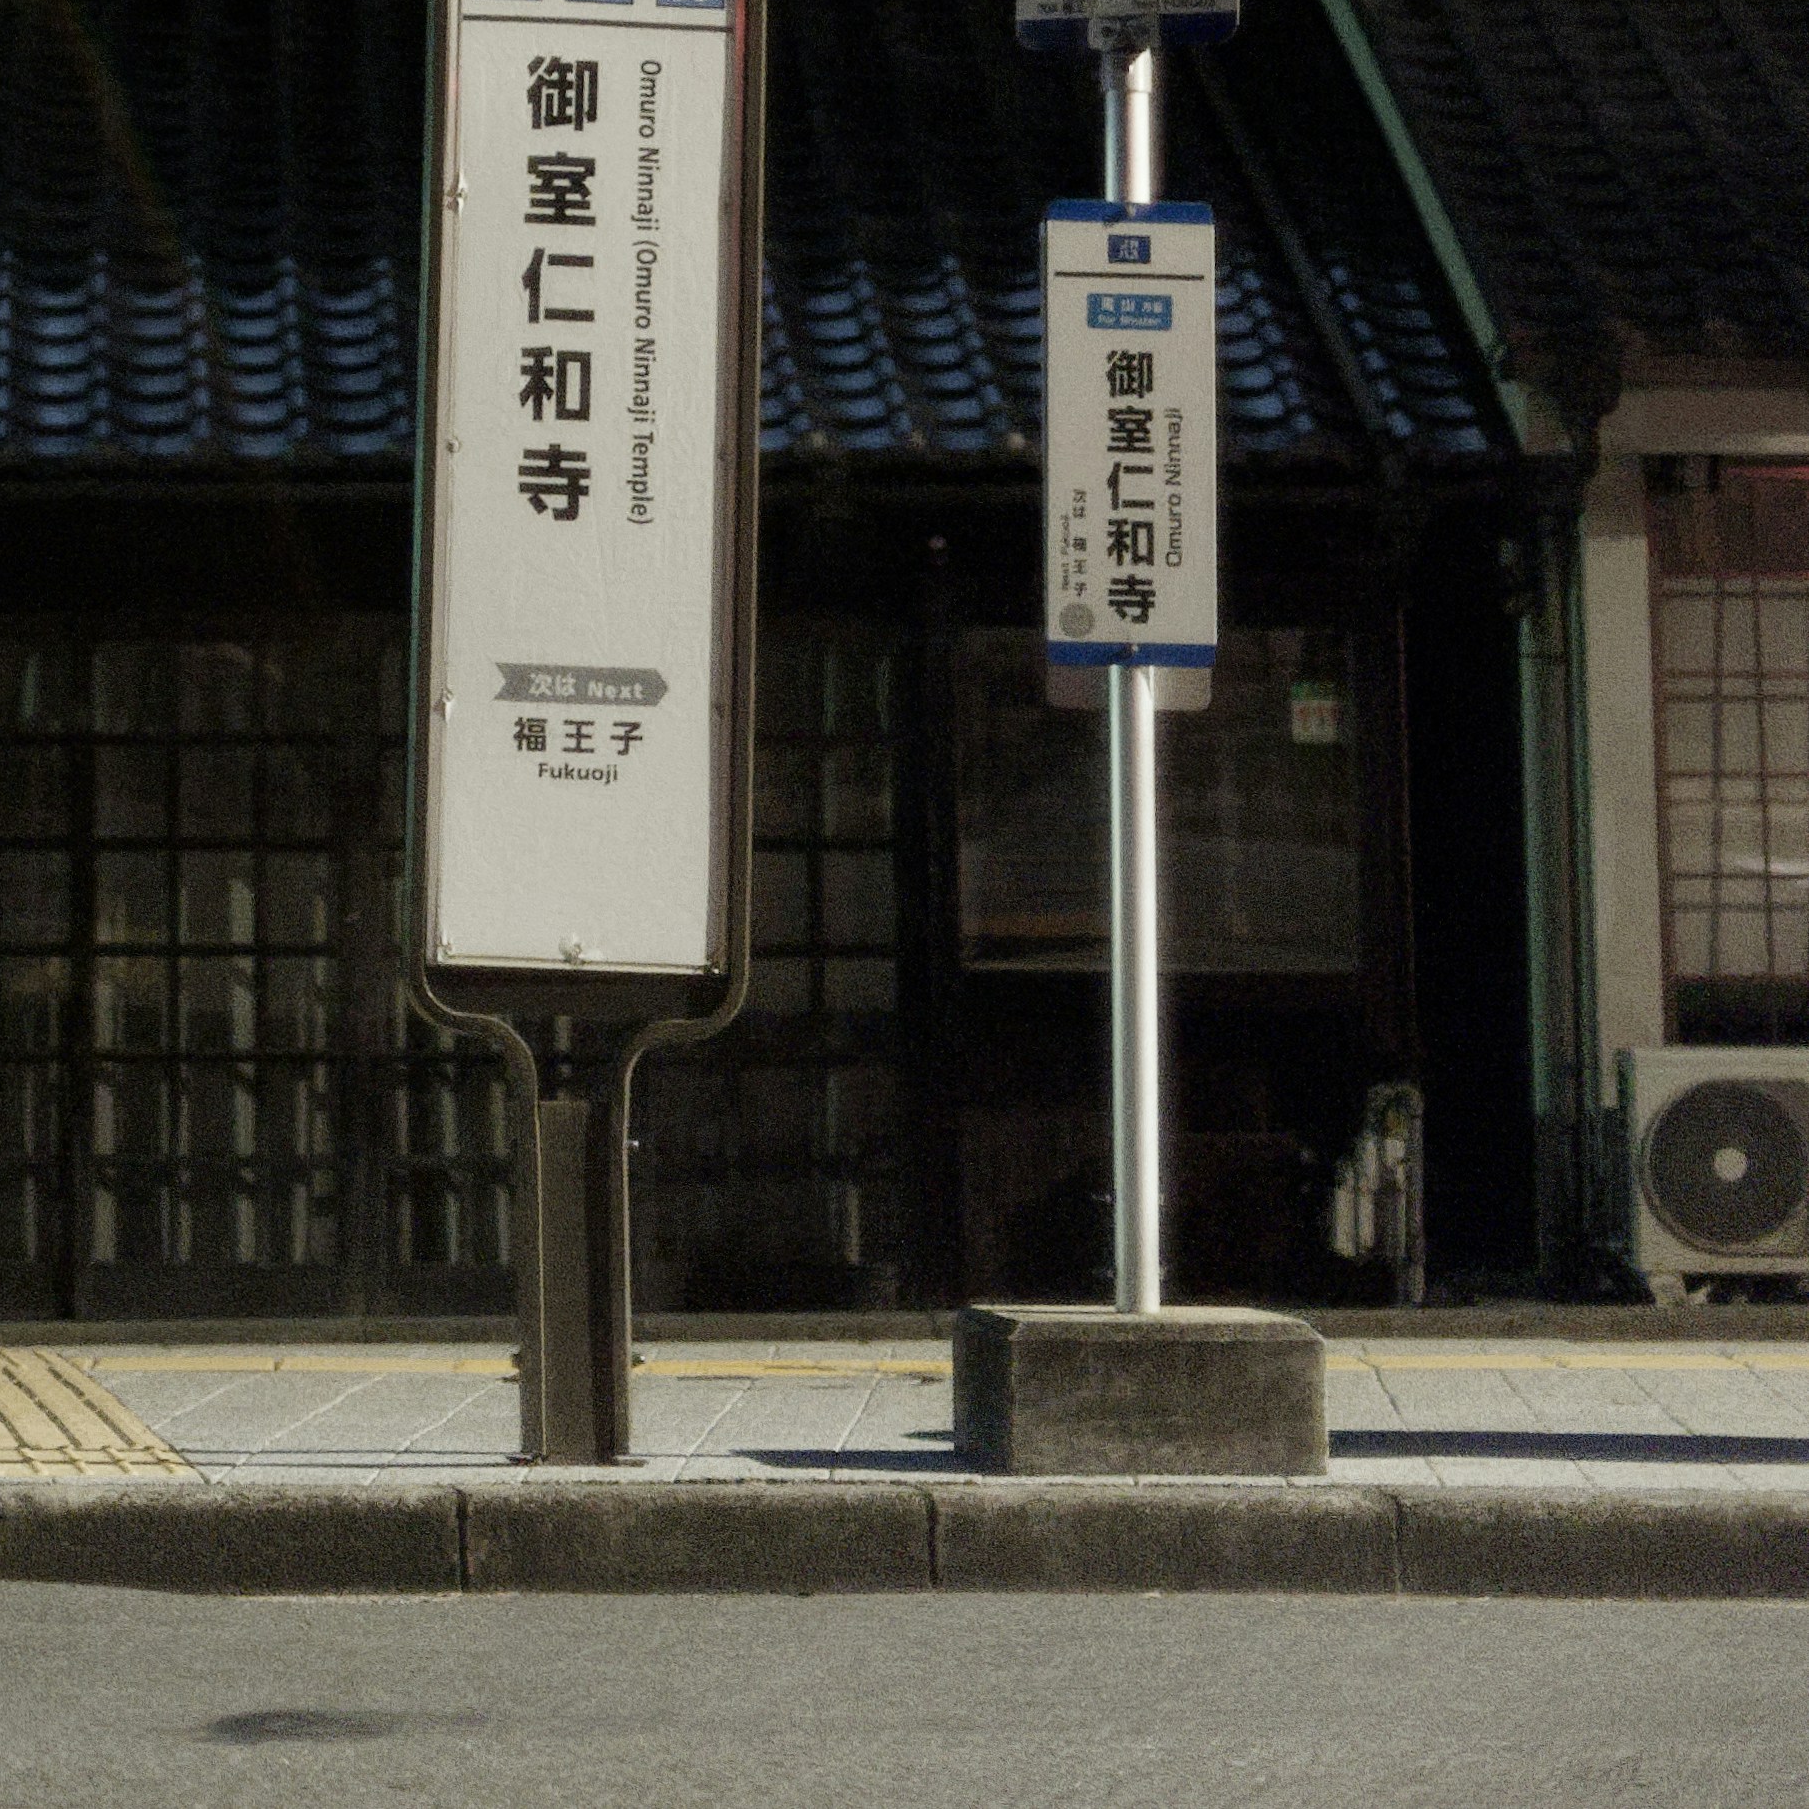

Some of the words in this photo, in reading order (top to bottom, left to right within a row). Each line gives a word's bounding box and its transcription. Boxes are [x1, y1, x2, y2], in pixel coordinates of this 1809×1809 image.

[639, 59, 662, 139] Omuro
[631, 147, 660, 232] Ninnaji
[517, 55, 600, 523] 御室仁和寺
[634, 240, 658, 329] (Omuro
[628, 337, 656, 424] Ninnaji
[626, 431, 655, 526] Temple)
[1105, 349, 1157, 625] 御室仁和寺
[1164, 407, 1184, 486] Ninnaji
[1164, 492, 1184, 568] Omuro
[529, 673, 576, 698] 次は
[587, 679, 644, 699] Next
[513, 716, 643, 756] 福王子
[537, 762, 619, 785] Fukuoji
